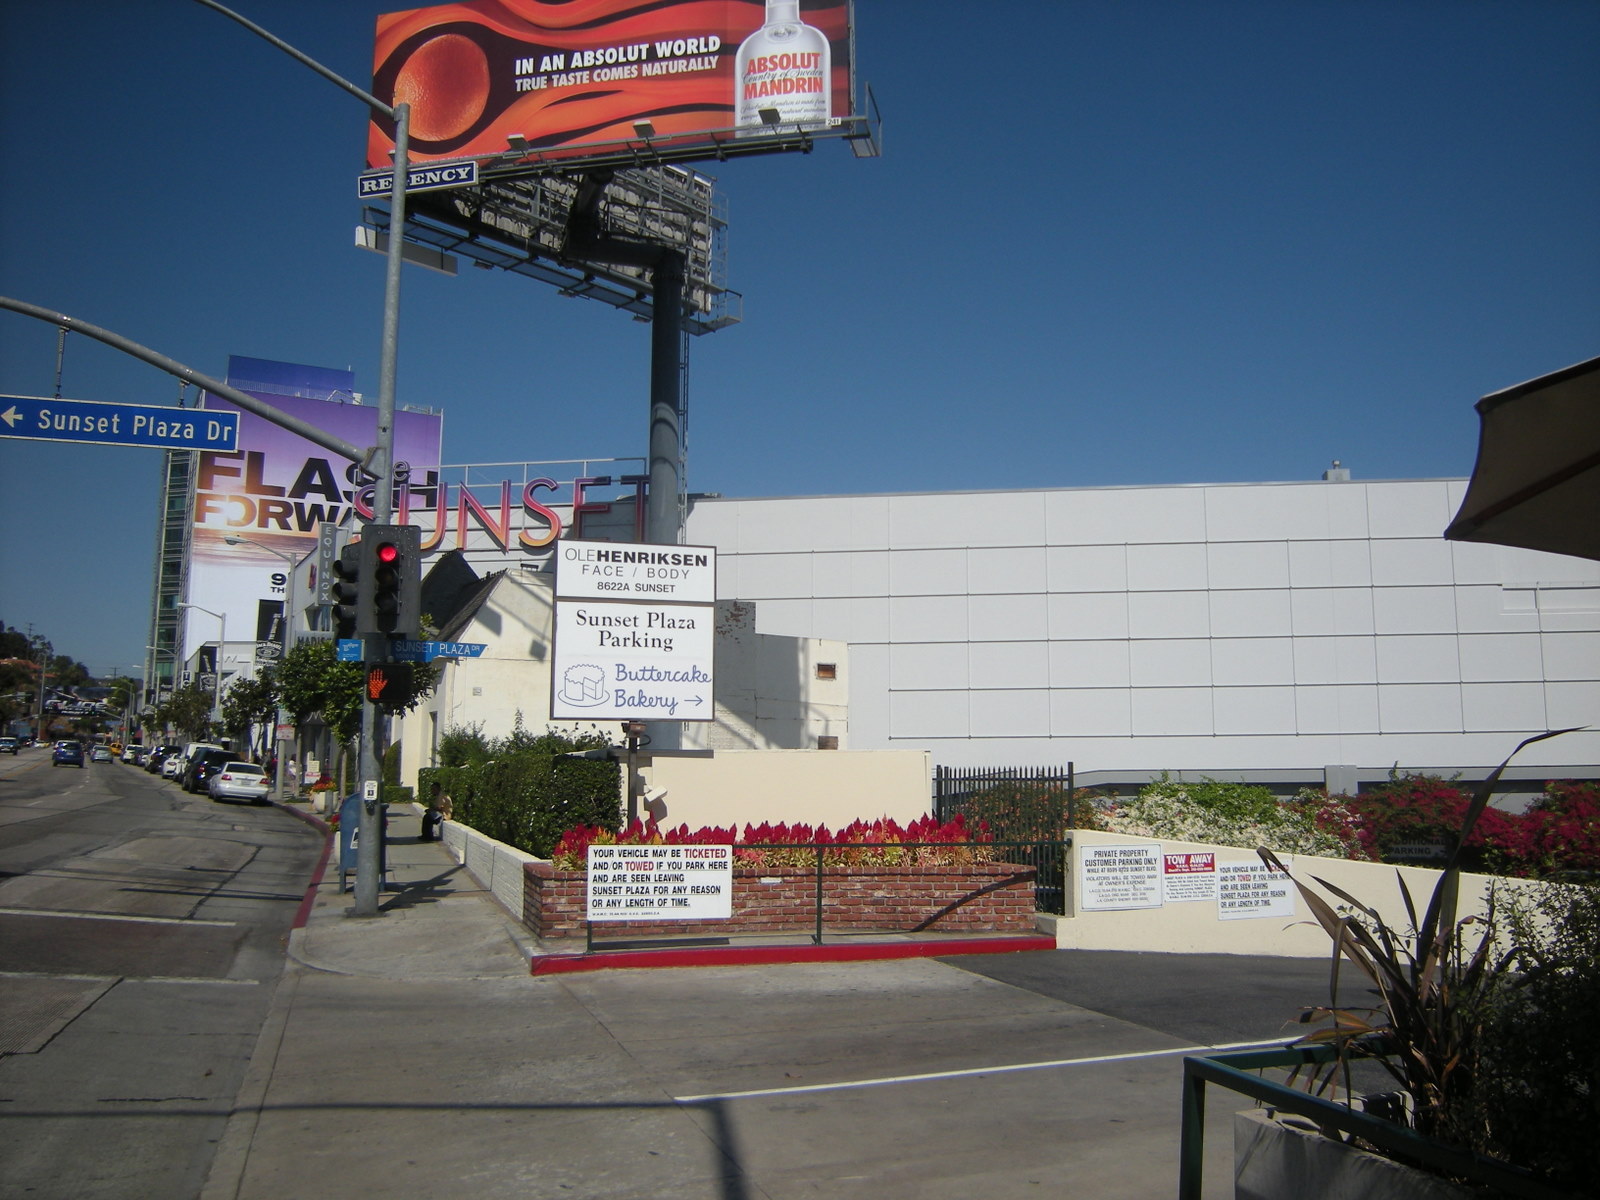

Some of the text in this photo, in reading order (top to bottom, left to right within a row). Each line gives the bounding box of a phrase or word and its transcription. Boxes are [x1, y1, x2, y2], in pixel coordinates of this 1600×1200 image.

[515, 36, 721, 75] IN AN ABSOLUT WORLD
[746, 52, 821, 75] ABSOLUT
[515, 55, 720, 92] TRUE TASTE COMES NATURALLY
[744, 77, 824, 100] MANDRIN
[828, 118, 840, 126] 241
[362, 167, 472, 192] REENCY
[38, 409, 232, 442] Sunset Plaza Dr
[321, 527, 332, 600] EQUINOX
[582, 564, 624, 577] FACE
[647, 567, 690, 579] BODY
[597, 582, 676, 593] 8622A SUNSET
[576, 609, 696, 630] Sunset Plaza
[395, 640, 434, 653] SUNSET
[439, 643, 471, 655] PLAZA
[599, 630, 674, 652] Parking
[615, 663, 712, 684] Buttercake
[614, 688, 679, 716] Bakery
[593, 848, 727, 859] YOUR VEHICLE MAY BE TICKETED
[1094, 849, 1149, 858] PRIVATE PROPERTY
[1166, 854, 1213, 865] TOW AWAY
[625, 861, 654, 871] TOWED
[656, 861, 663, 870] IF
[667, 861, 682, 870] YOU
[686, 861, 705, 870] PARK
[708, 861, 728, 870] HERE
[1085, 859, 1116, 867] CUSTOMER
[1118, 858, 1143, 866] PARKING
[593, 873, 685, 883] AND ARE SEEN LEAVING
[1237, 874, 1252, 882] TOWED
[592, 885, 721, 895] SUNSET PLAZA FOR ANY REASON
[592, 898, 691, 908] OR ANY LENGTH OF TIME.
